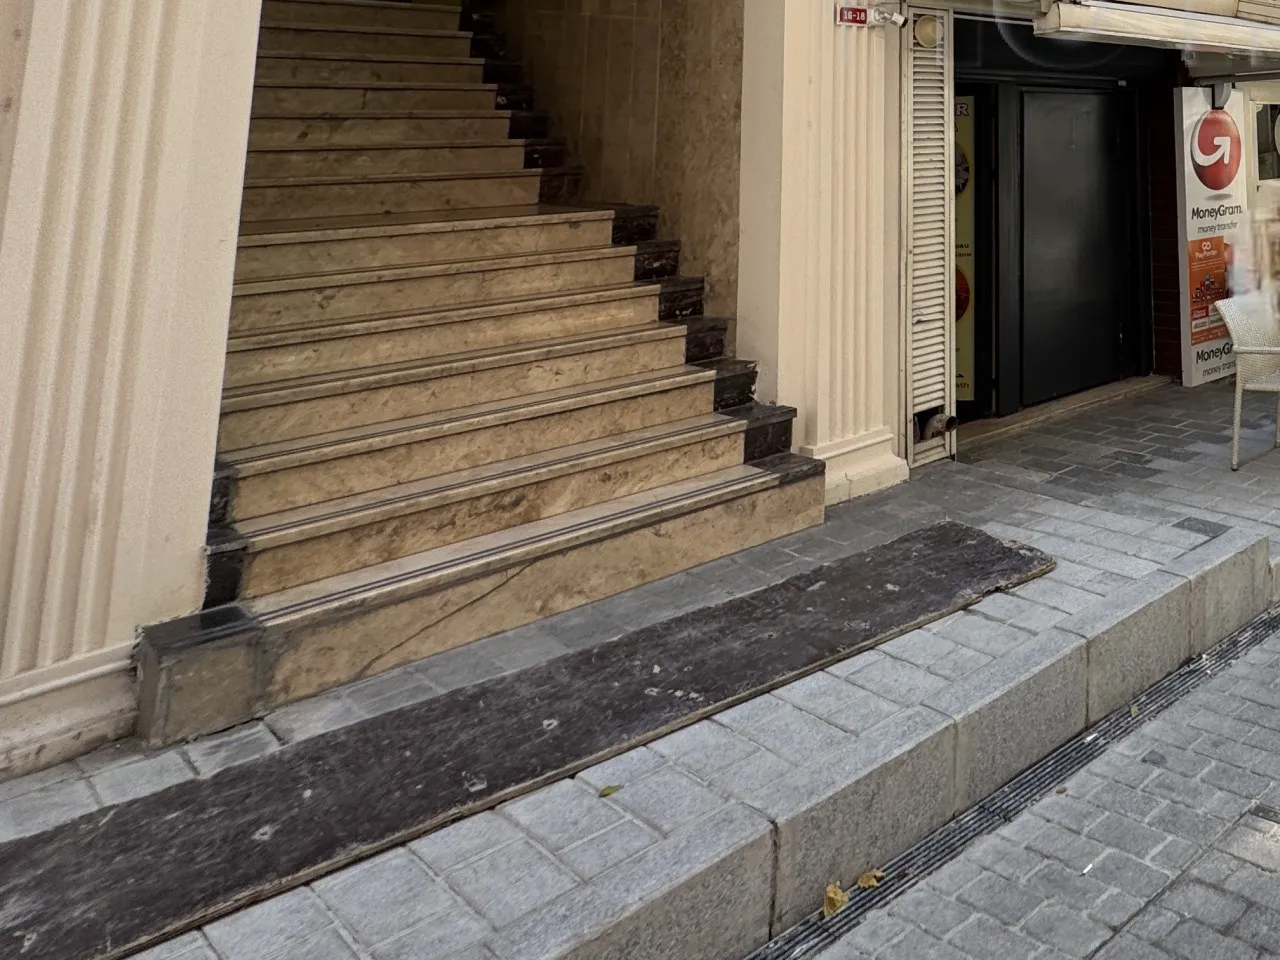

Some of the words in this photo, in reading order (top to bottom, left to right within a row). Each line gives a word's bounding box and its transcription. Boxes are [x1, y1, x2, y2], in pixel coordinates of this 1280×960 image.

[843, 10, 866, 21] 16-18
[1197, 223, 1217, 234] money
[1195, 342, 1234, 364] MoneyGr
